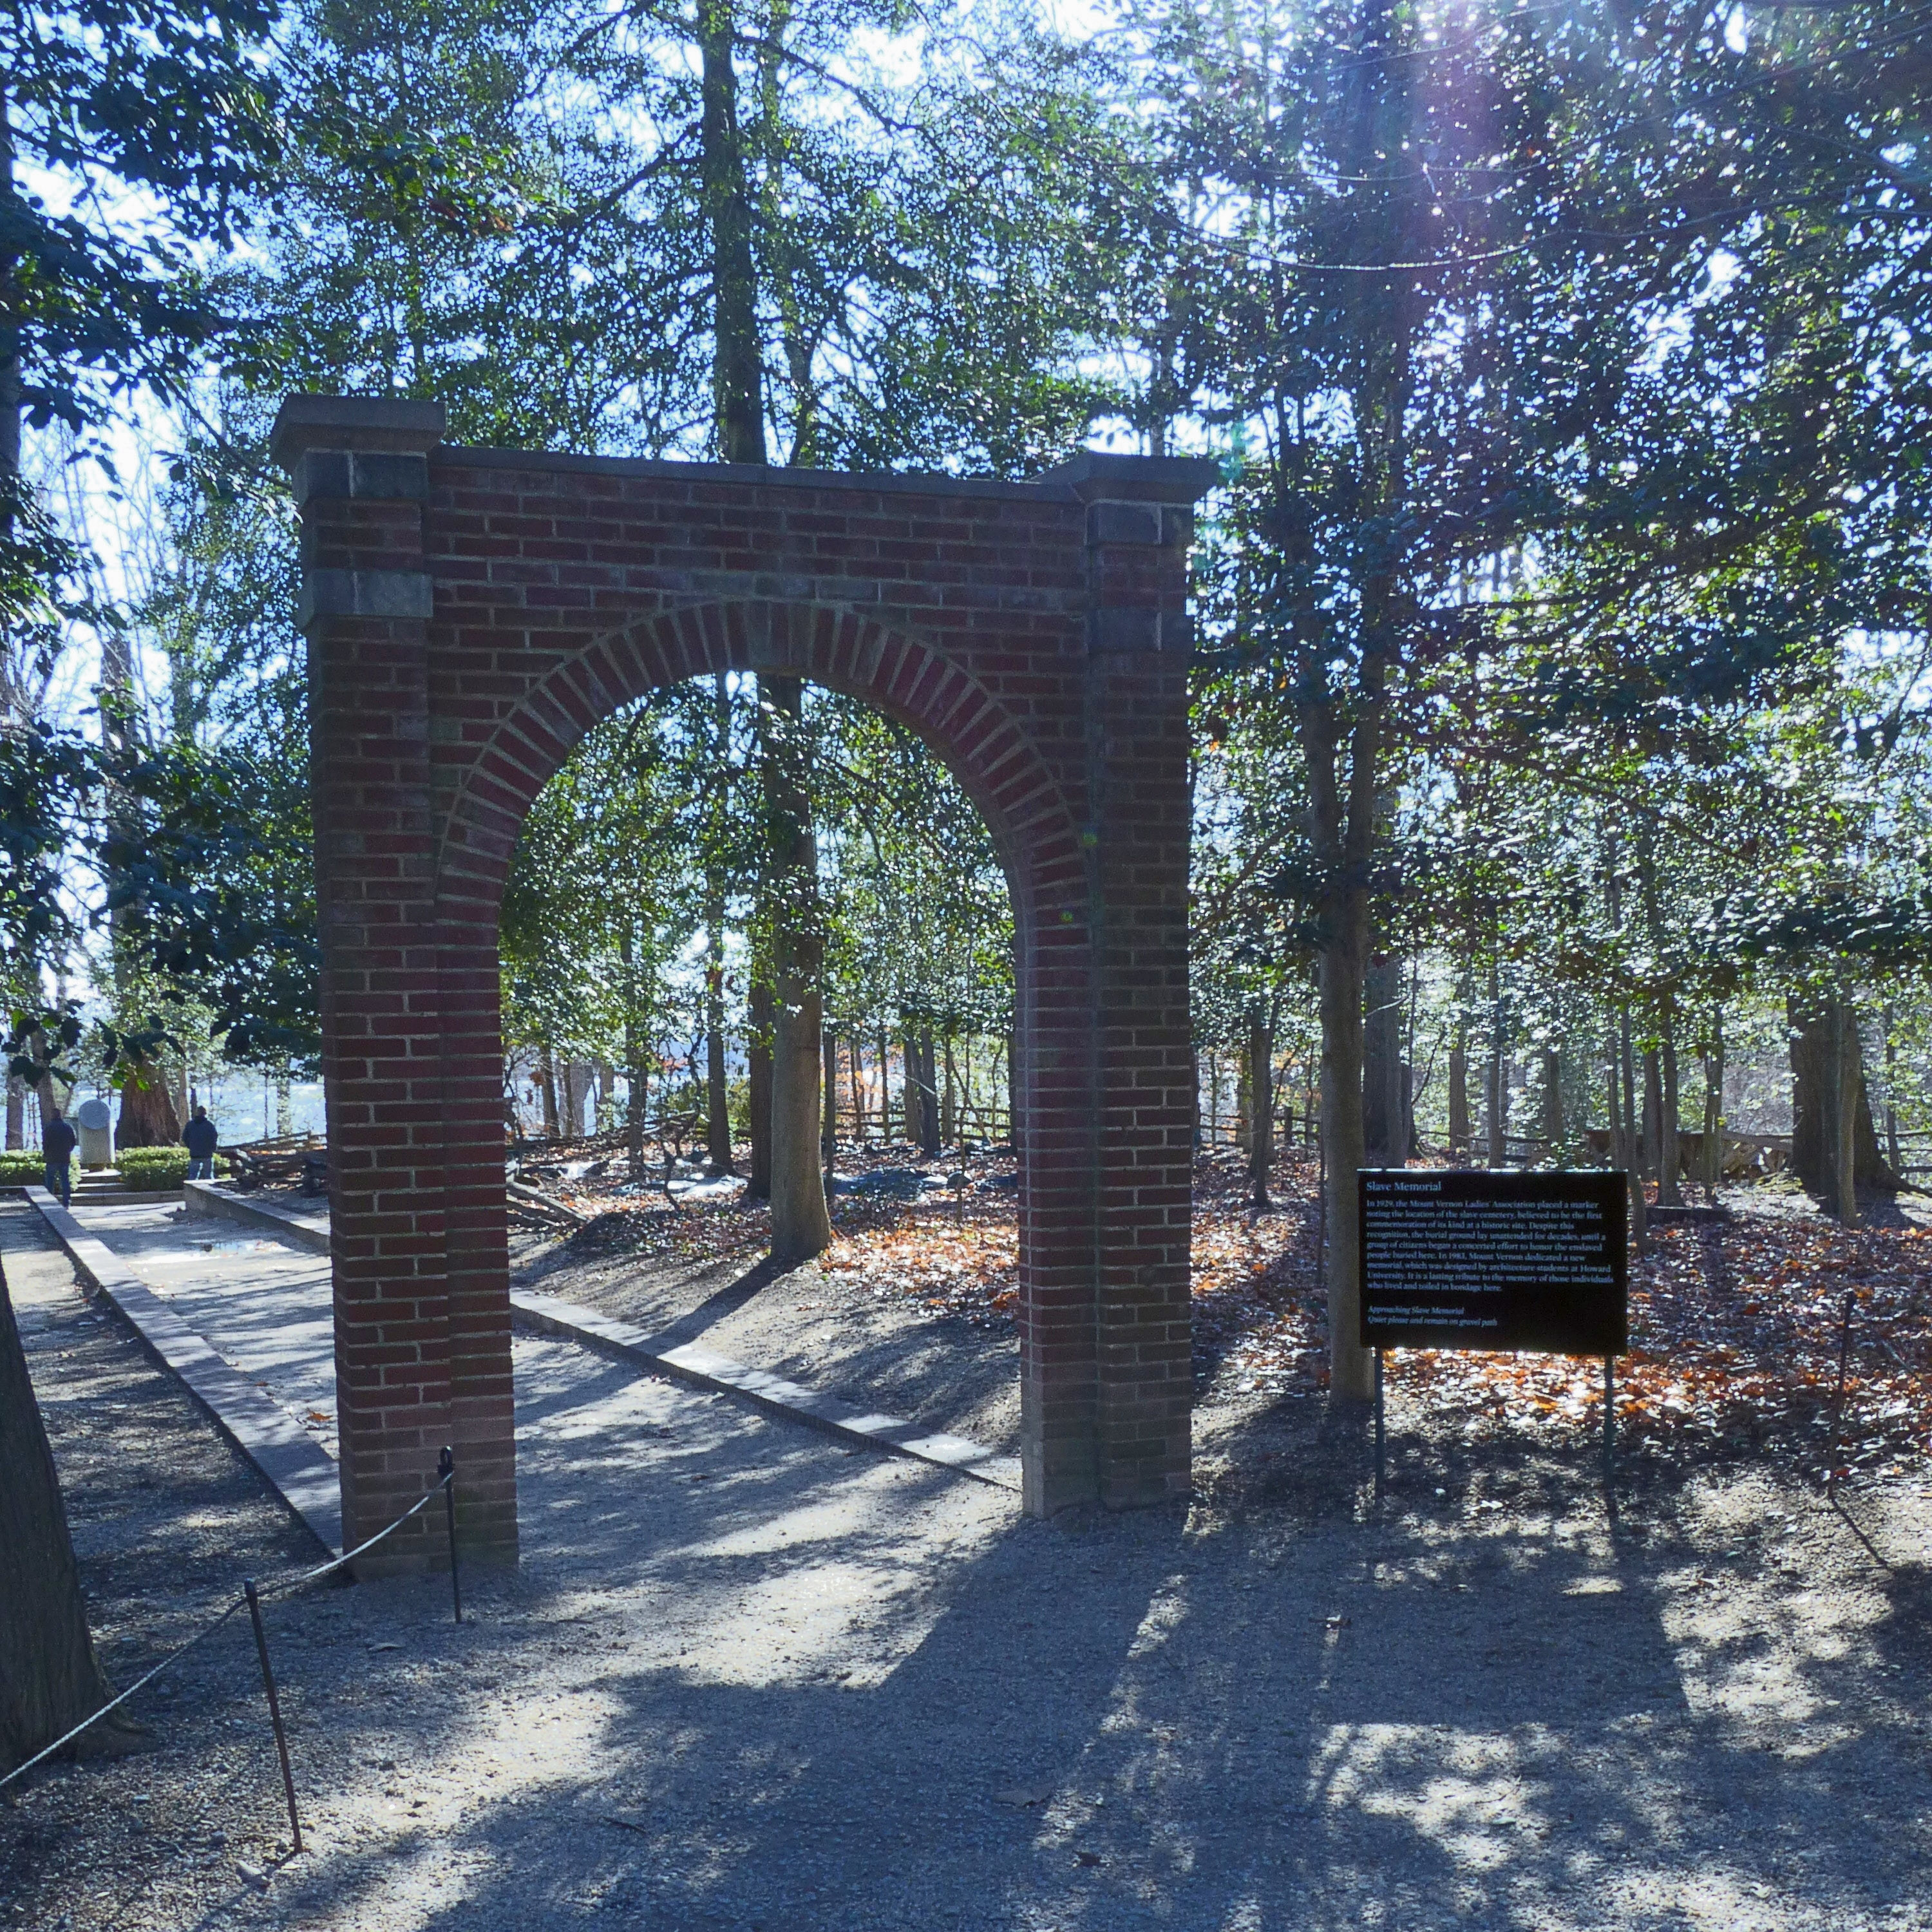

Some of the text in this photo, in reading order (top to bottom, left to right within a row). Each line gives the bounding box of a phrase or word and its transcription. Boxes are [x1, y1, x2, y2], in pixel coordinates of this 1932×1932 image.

[1366, 1181, 1441, 1191] Slave Memorial
[1537, 1201, 1562, 1209] placed
[1367, 1210, 1390, 1218] noting
[1530, 1222, 1558, 1231] Despite
[1448, 1232, 1475, 1240] ground
[1477, 1232, 1488, 1240] lay
[1428, 1242, 1450, 1251] began
[1367, 1251, 1391, 1260] people
[1444, 1263, 1477, 1272] designed
[1479, 1264, 1487, 1272] by
[1430, 1273, 1454, 1282] lasting
[1450, 1283, 1482, 1292] bondage
[1368, 1306, 1410, 1315] Approaching
[1459, 1318, 1481, 1327] gravel
[1482, 1319, 1497, 1328] path
